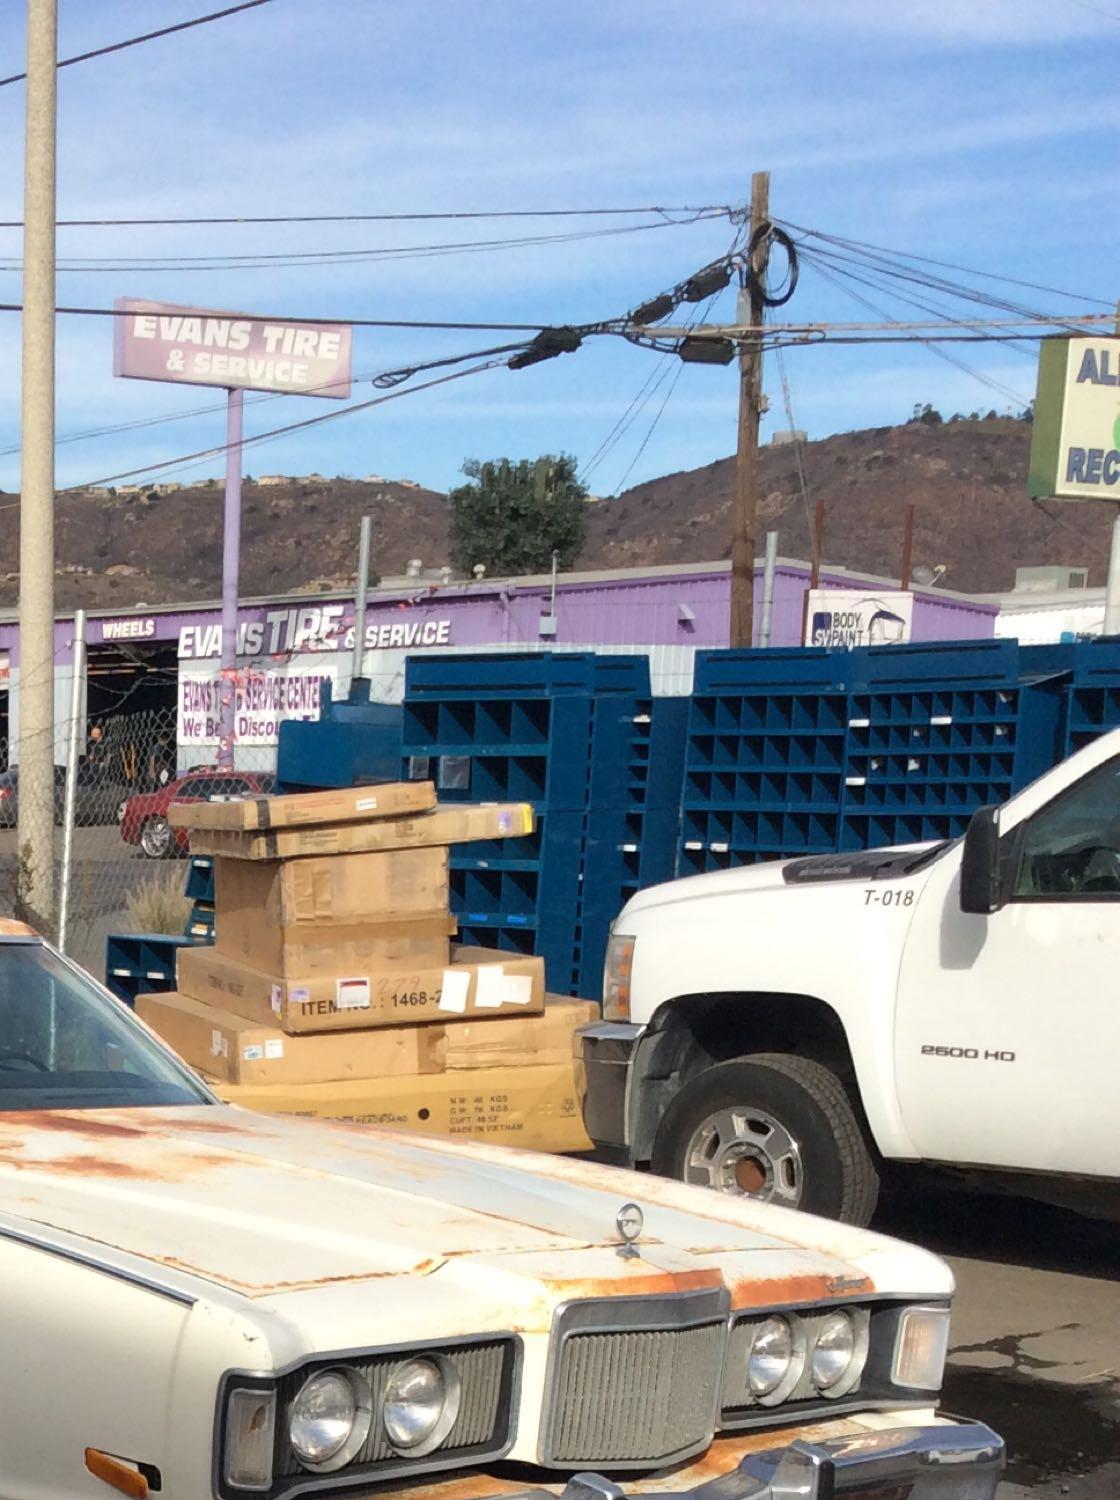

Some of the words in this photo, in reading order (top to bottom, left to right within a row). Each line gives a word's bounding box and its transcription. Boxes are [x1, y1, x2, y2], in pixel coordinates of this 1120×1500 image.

[133, 315, 251, 350] EVANS
[263, 325, 341, 360] TIRE
[166, 348, 185, 371] &
[193, 352, 309, 386] SERVICE
[1076, 348, 1120, 386] AL
[102, 619, 155, 640] WHEELS
[266, 606, 344, 653] TIRE
[364, 620, 450, 648] SERVICE
[833, 612, 862, 628] BODY
[183, 680, 211, 712] EVANS
[246, 677, 285, 711] SERVICE
[183, 718, 201, 737] We
[864, 889, 914, 906] T-018
[921, 1045, 978, 1060] 2500
[984, 1050, 1016, 1062] HD
